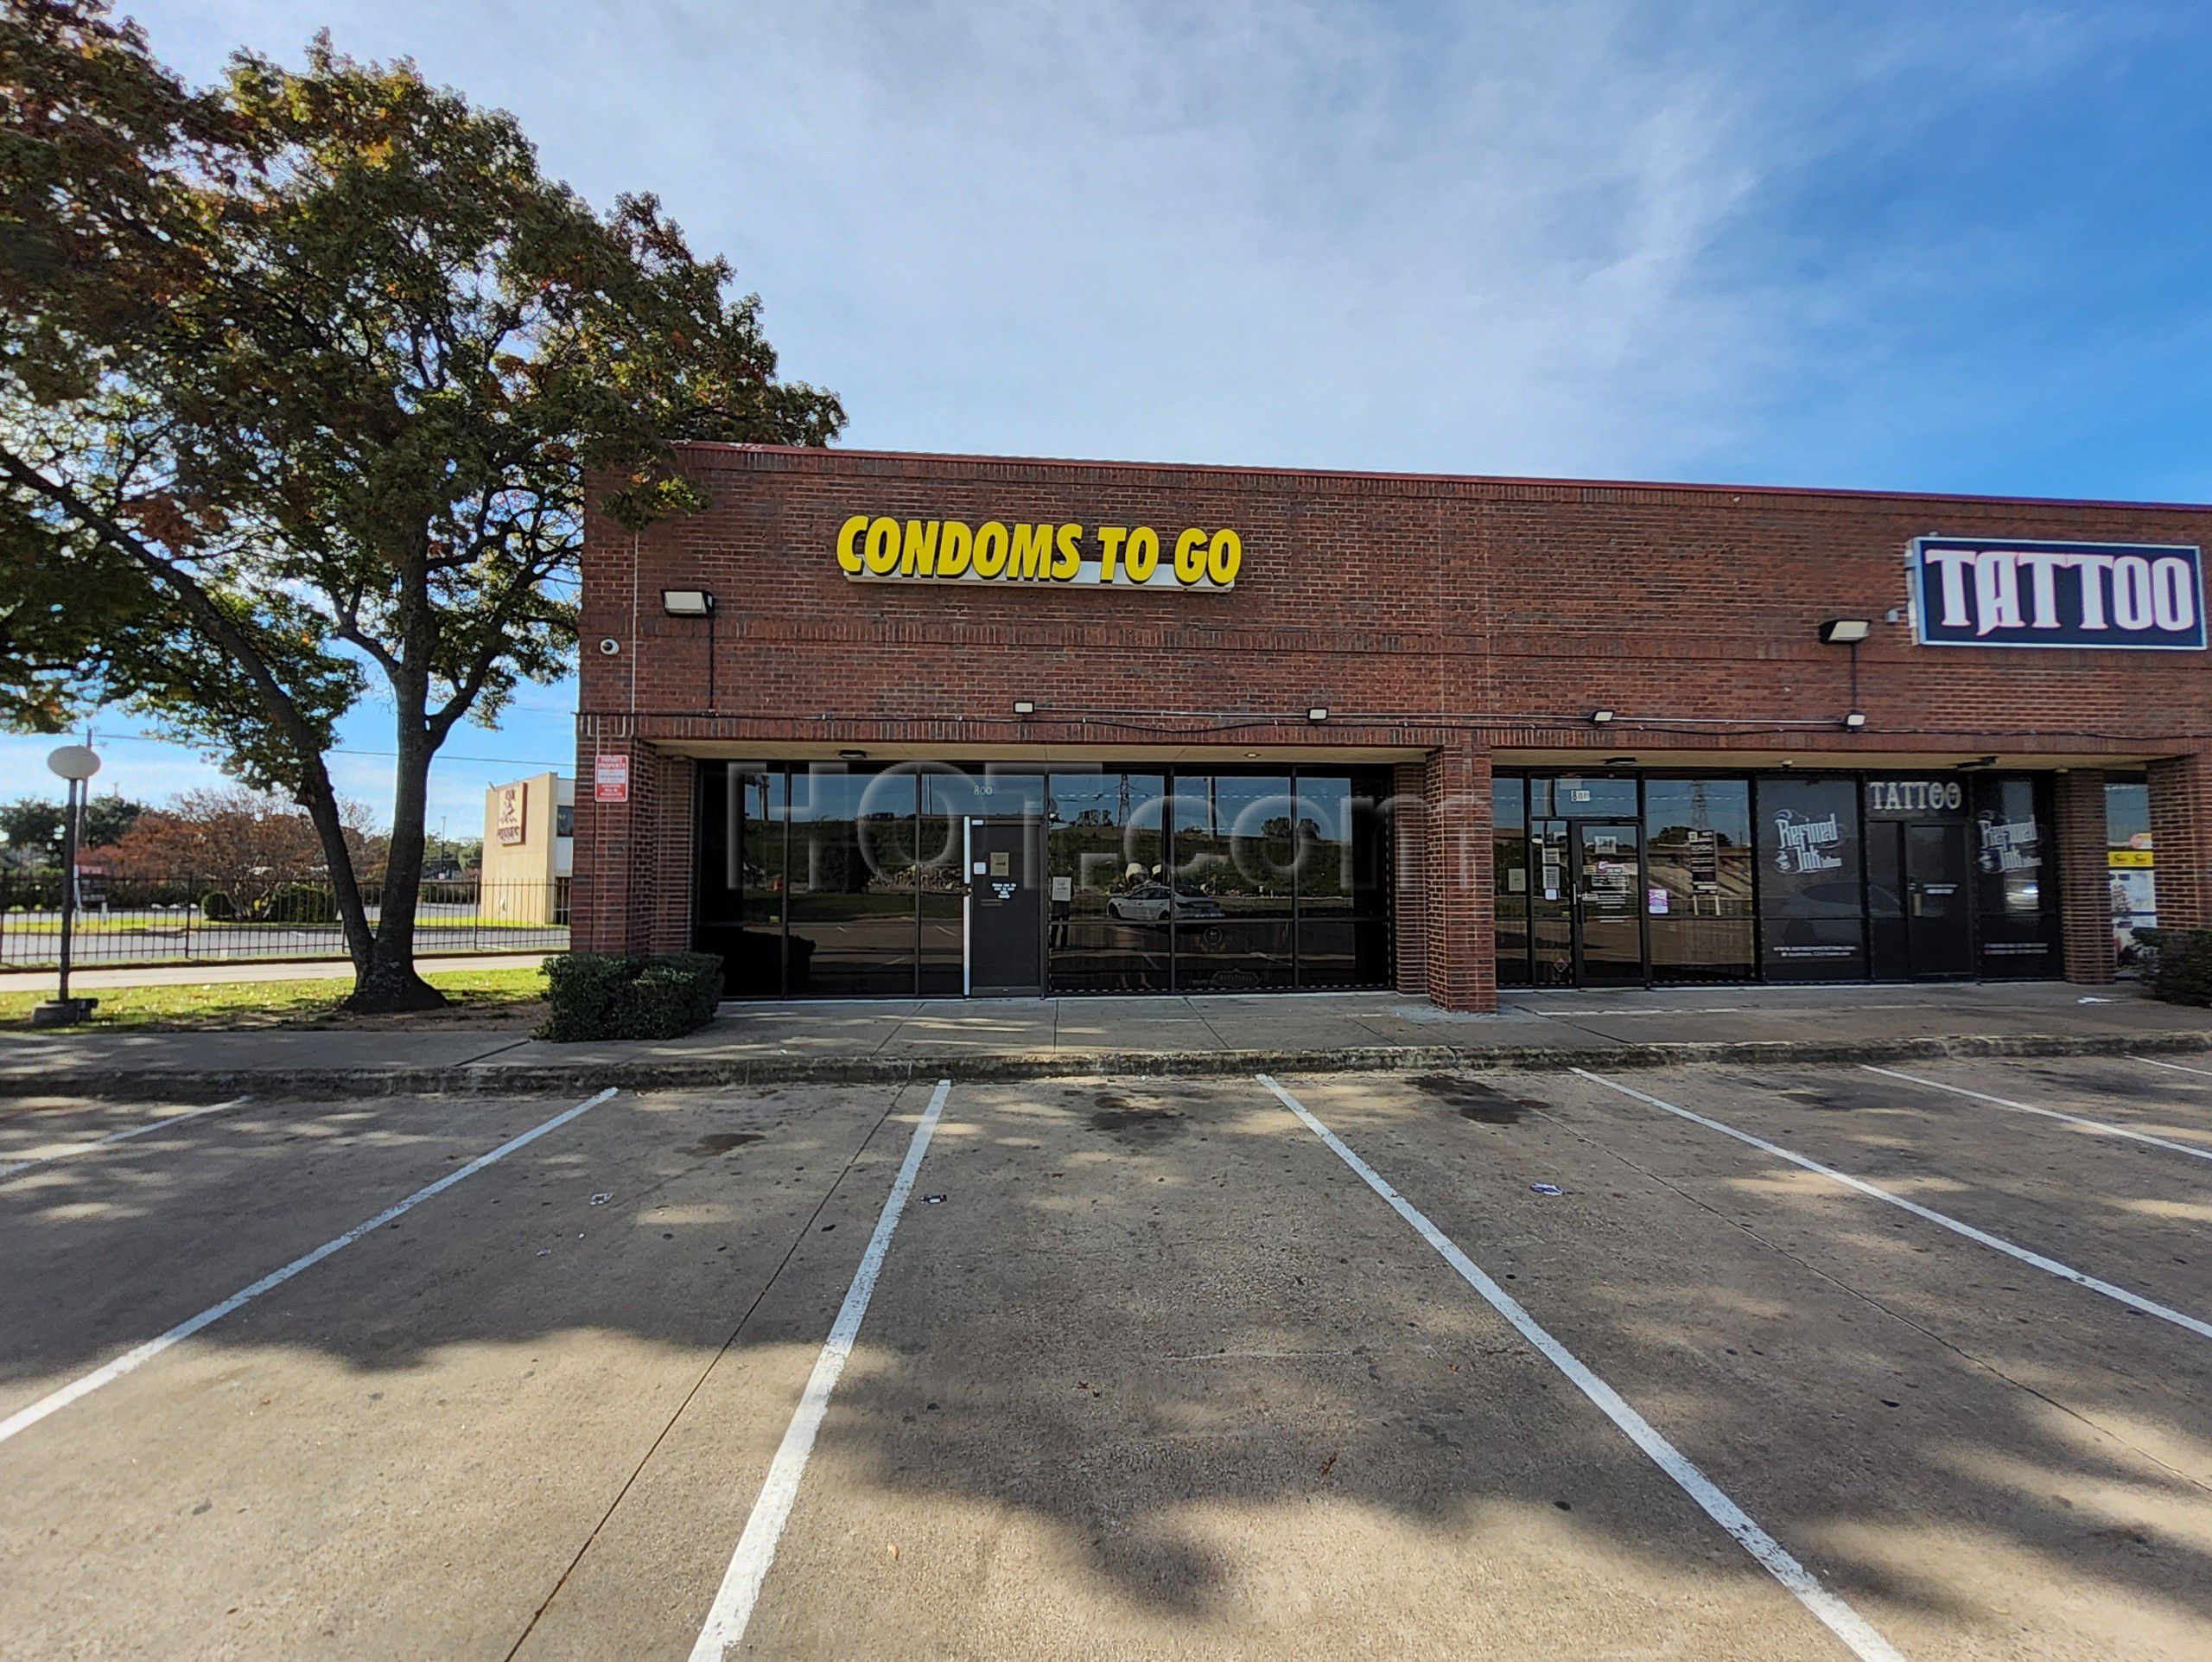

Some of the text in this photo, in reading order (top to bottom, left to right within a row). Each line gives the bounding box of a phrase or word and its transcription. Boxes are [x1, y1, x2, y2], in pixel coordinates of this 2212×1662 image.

[836, 514, 1242, 585] CONDOMS TO GO
[1924, 548, 2195, 637] TATTOO
[973, 785, 993, 796] 800
[1869, 780, 1961, 810] TATTOO
[1775, 812, 1839, 852] Refined
[1977, 813, 2037, 852] Refined
[1796, 844, 1823, 872] Ink
[1999, 844, 2023, 872] Ink
